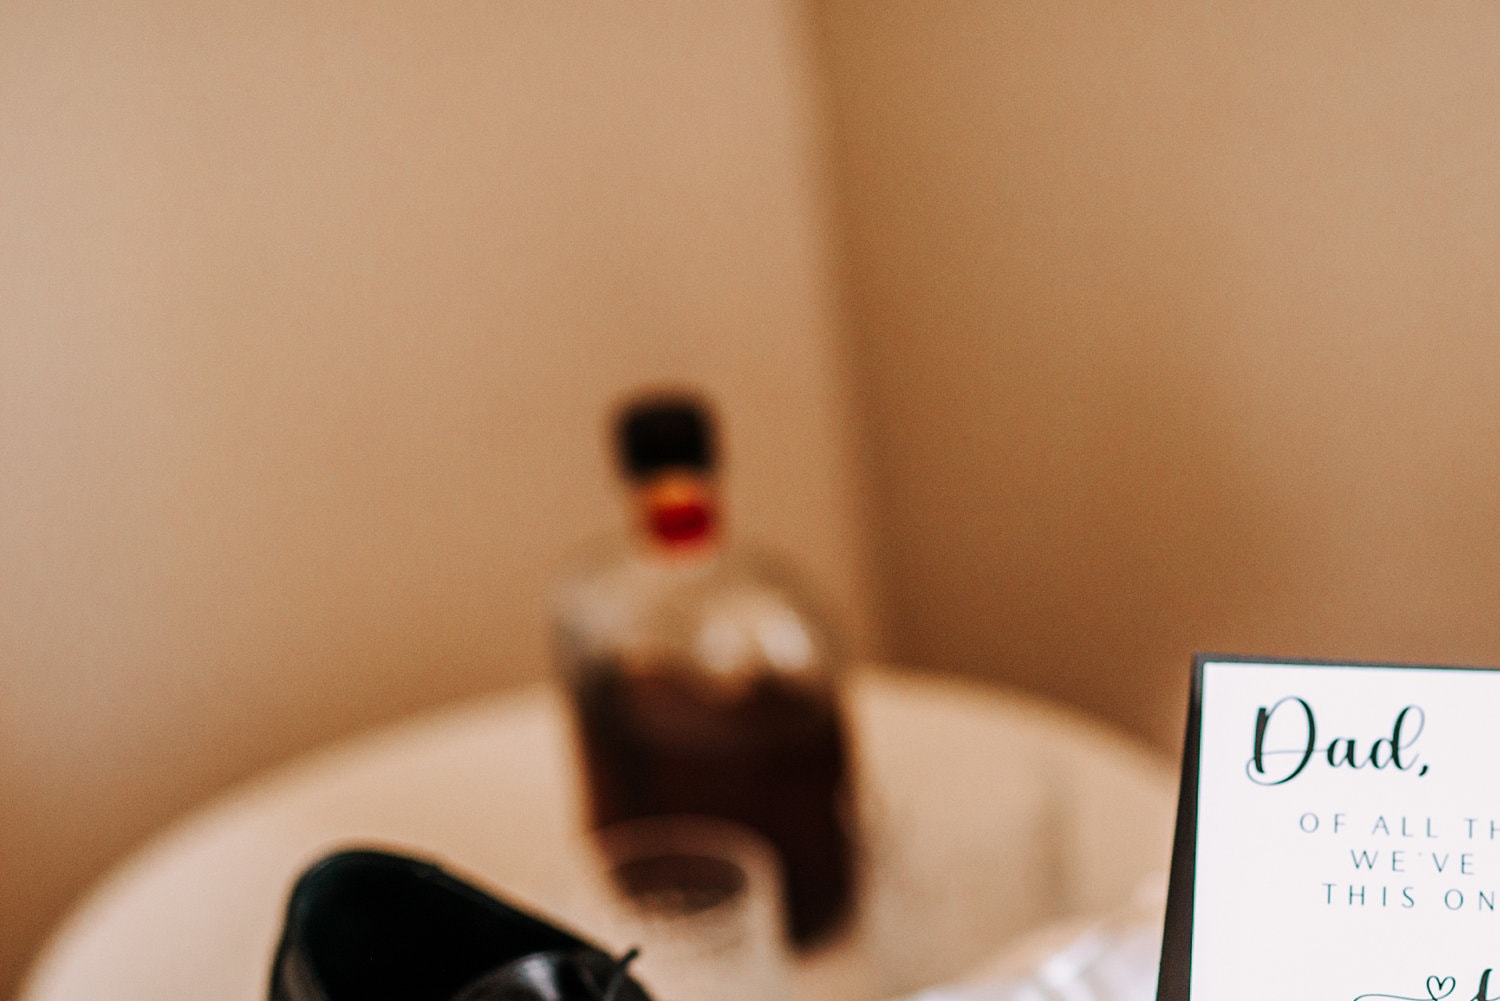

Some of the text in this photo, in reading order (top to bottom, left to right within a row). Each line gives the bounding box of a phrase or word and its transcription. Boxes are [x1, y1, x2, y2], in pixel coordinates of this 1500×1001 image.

[1245, 695, 1430, 787] Dad,
[1299, 812, 1349, 835] OF
[1372, 815, 1440, 839] ALL
[1350, 849, 1476, 875] WE'VE
[1321, 883, 1416, 909] THIS
